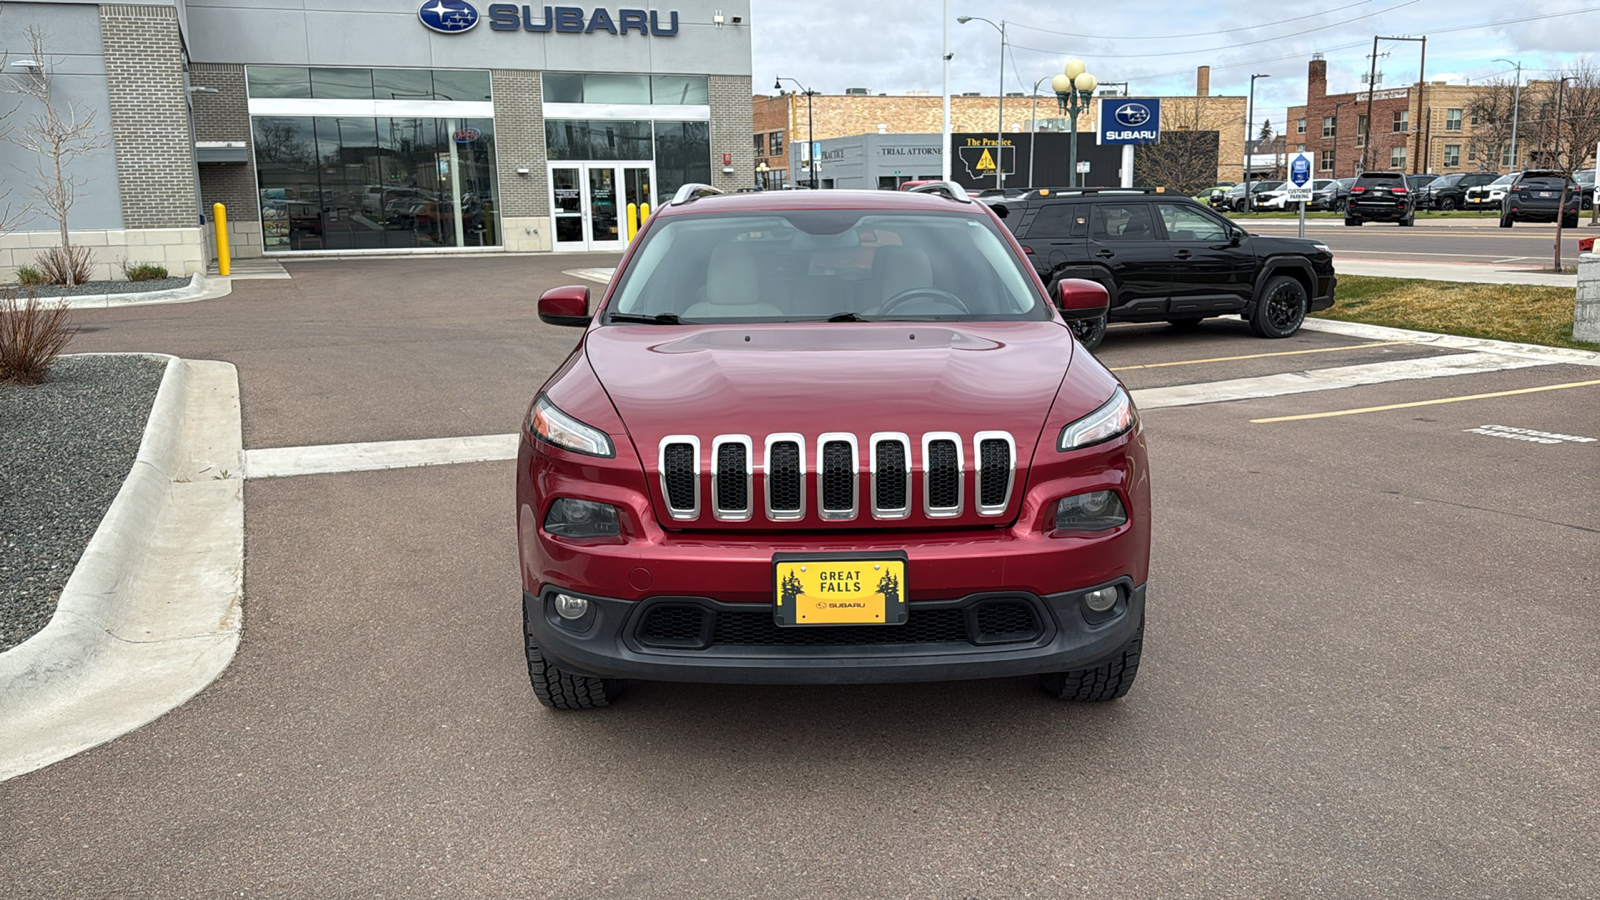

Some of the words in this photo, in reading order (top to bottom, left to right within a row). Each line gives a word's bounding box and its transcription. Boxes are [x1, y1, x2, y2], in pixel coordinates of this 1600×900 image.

[488, 3, 679, 36] SUBARU
[453, 129, 479, 141] OPEN
[1105, 130, 1157, 140] SUBARU
[966, 138, 982, 147] The
[982, 138, 1012, 147] Pracice
[821, 148, 845, 160] PRACTICE
[881, 147, 906, 156] TRIAL
[906, 147, 943, 156] ATTORNE
[820, 571, 861, 581] GREAT
[820, 582, 861, 592] FALLS
